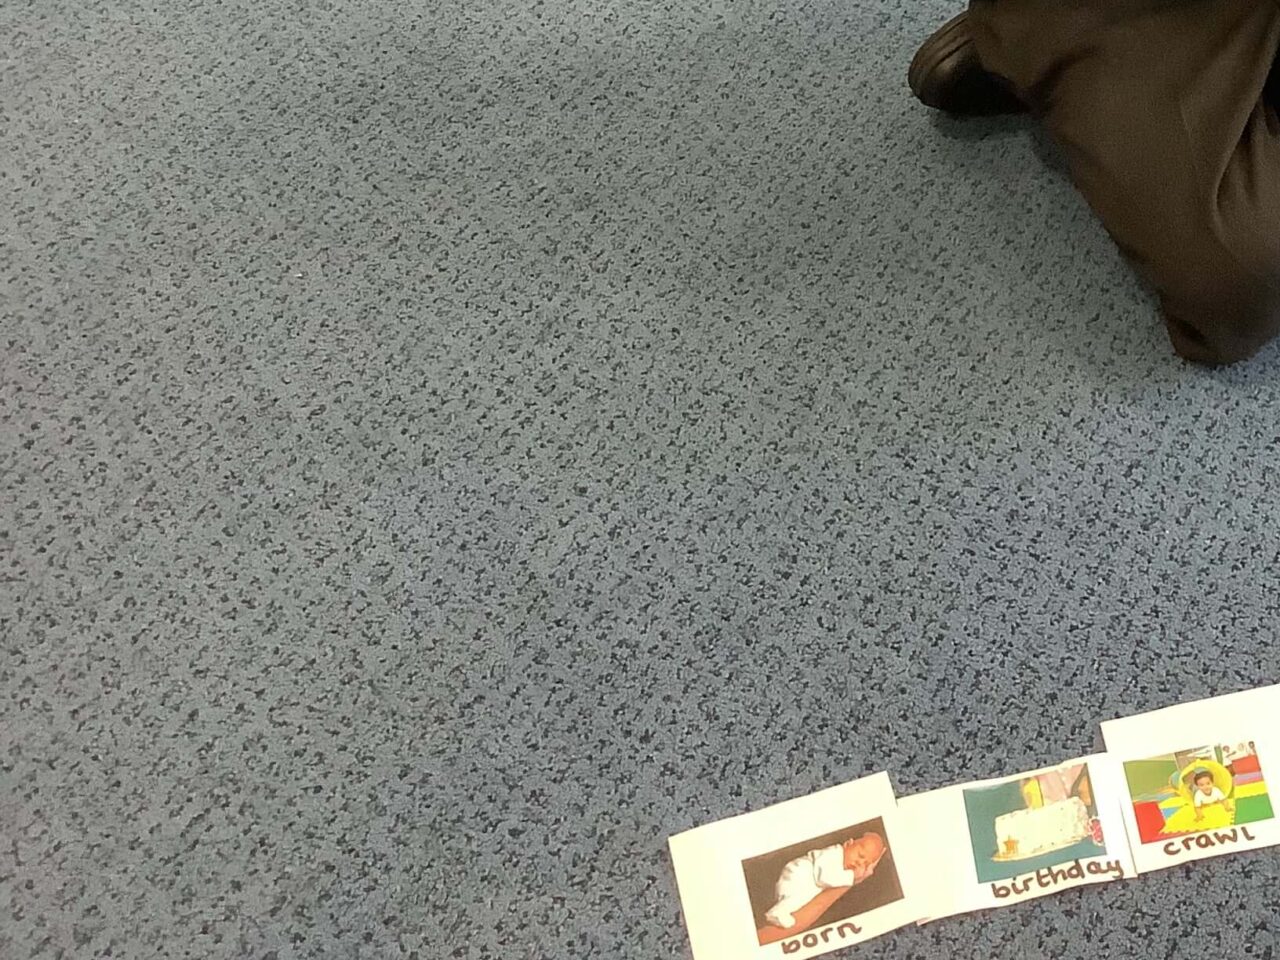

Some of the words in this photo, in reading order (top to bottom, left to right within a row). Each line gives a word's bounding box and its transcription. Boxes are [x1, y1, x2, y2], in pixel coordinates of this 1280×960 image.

[1163, 826, 1256, 857] crawl
[991, 858, 1125, 900] birthday
[781, 921, 862, 954] born
